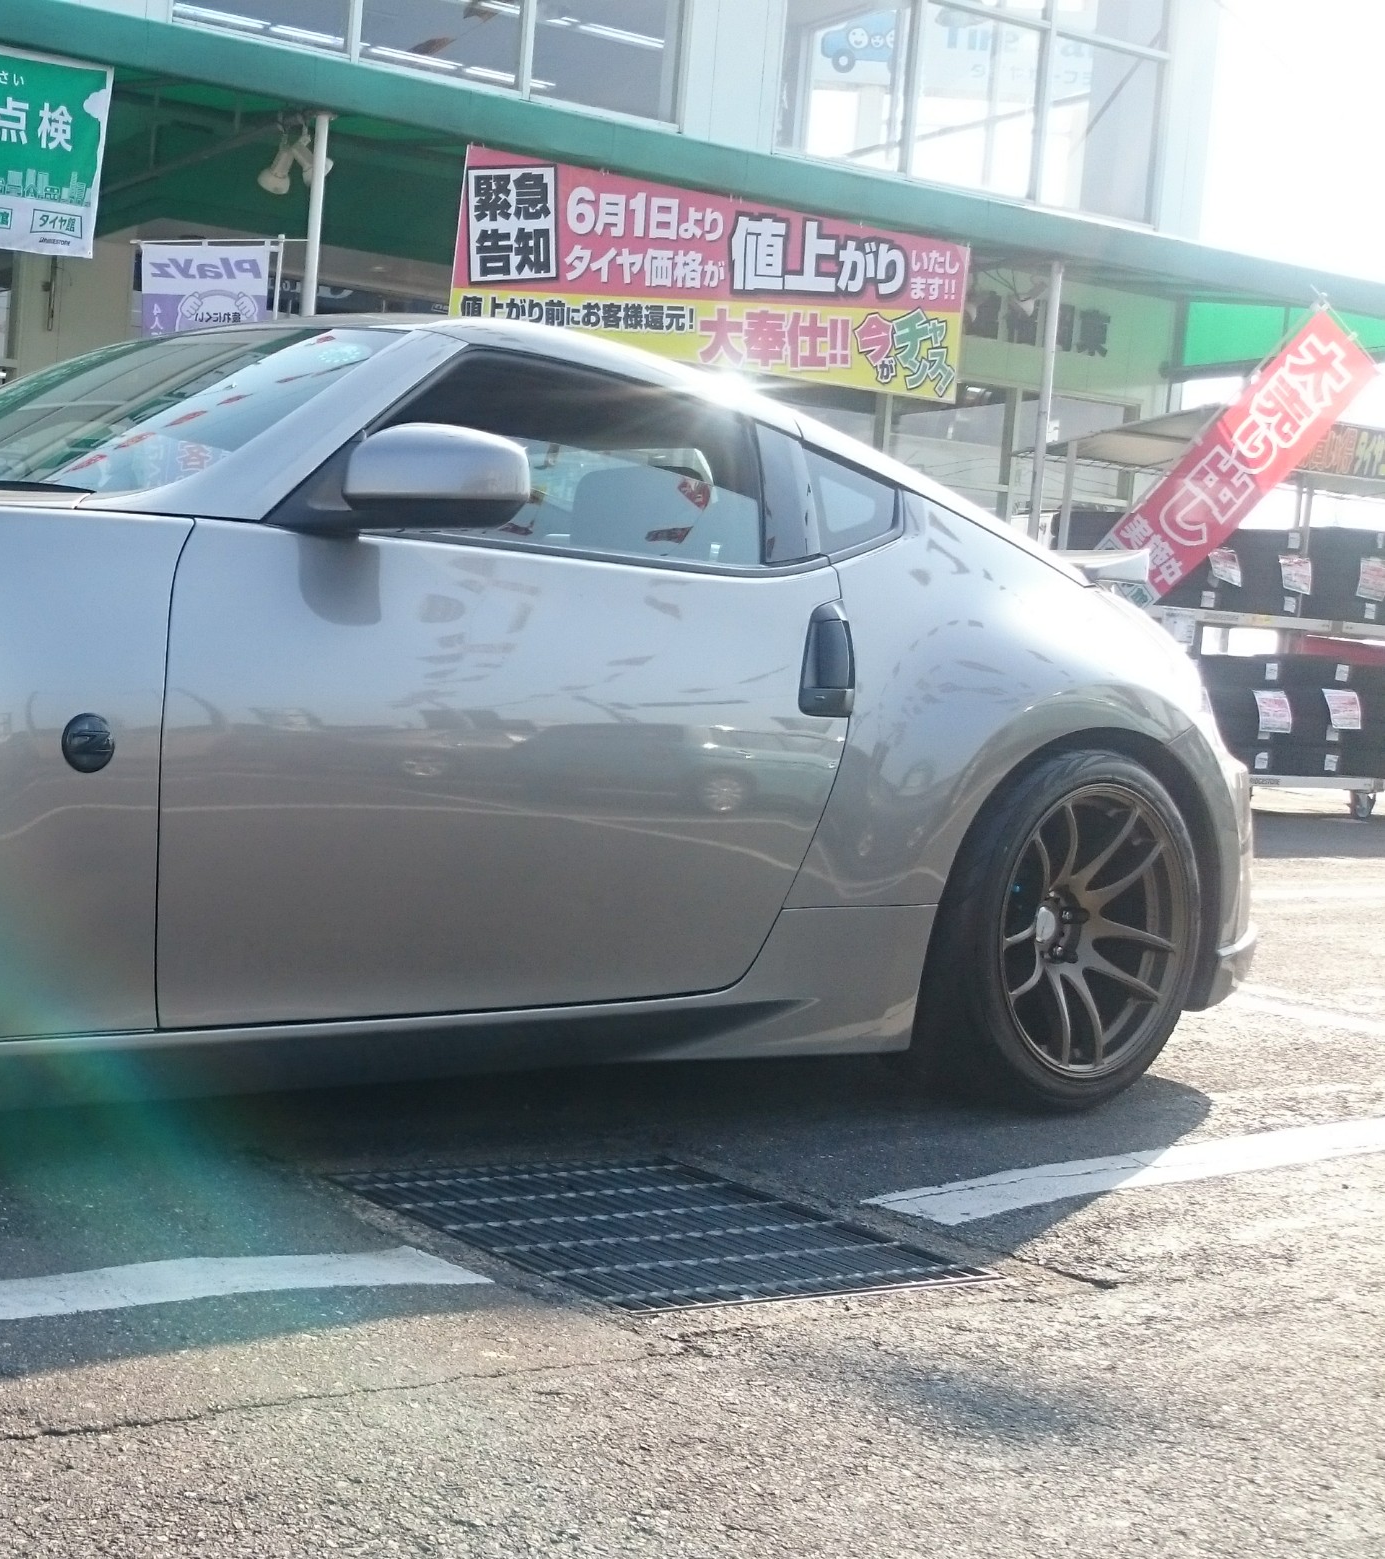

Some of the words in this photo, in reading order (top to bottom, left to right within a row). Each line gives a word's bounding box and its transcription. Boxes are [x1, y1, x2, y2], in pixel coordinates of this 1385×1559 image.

[473, 172, 551, 222] 緊急
[566, 186, 724, 242] 6月1日より
[38, 214, 77, 233] タイヤ館
[475, 227, 551, 277] 告知
[564, 245, 726, 289] タイヤ価格が
[730, 215, 906, 296] 値上がり
[911, 249, 960, 275] いたし
[910, 276, 956, 301] ます!!
[461, 295, 695, 331] 値上がり前にお客様還元!
[697, 305, 852, 371] 大奉仕!!
